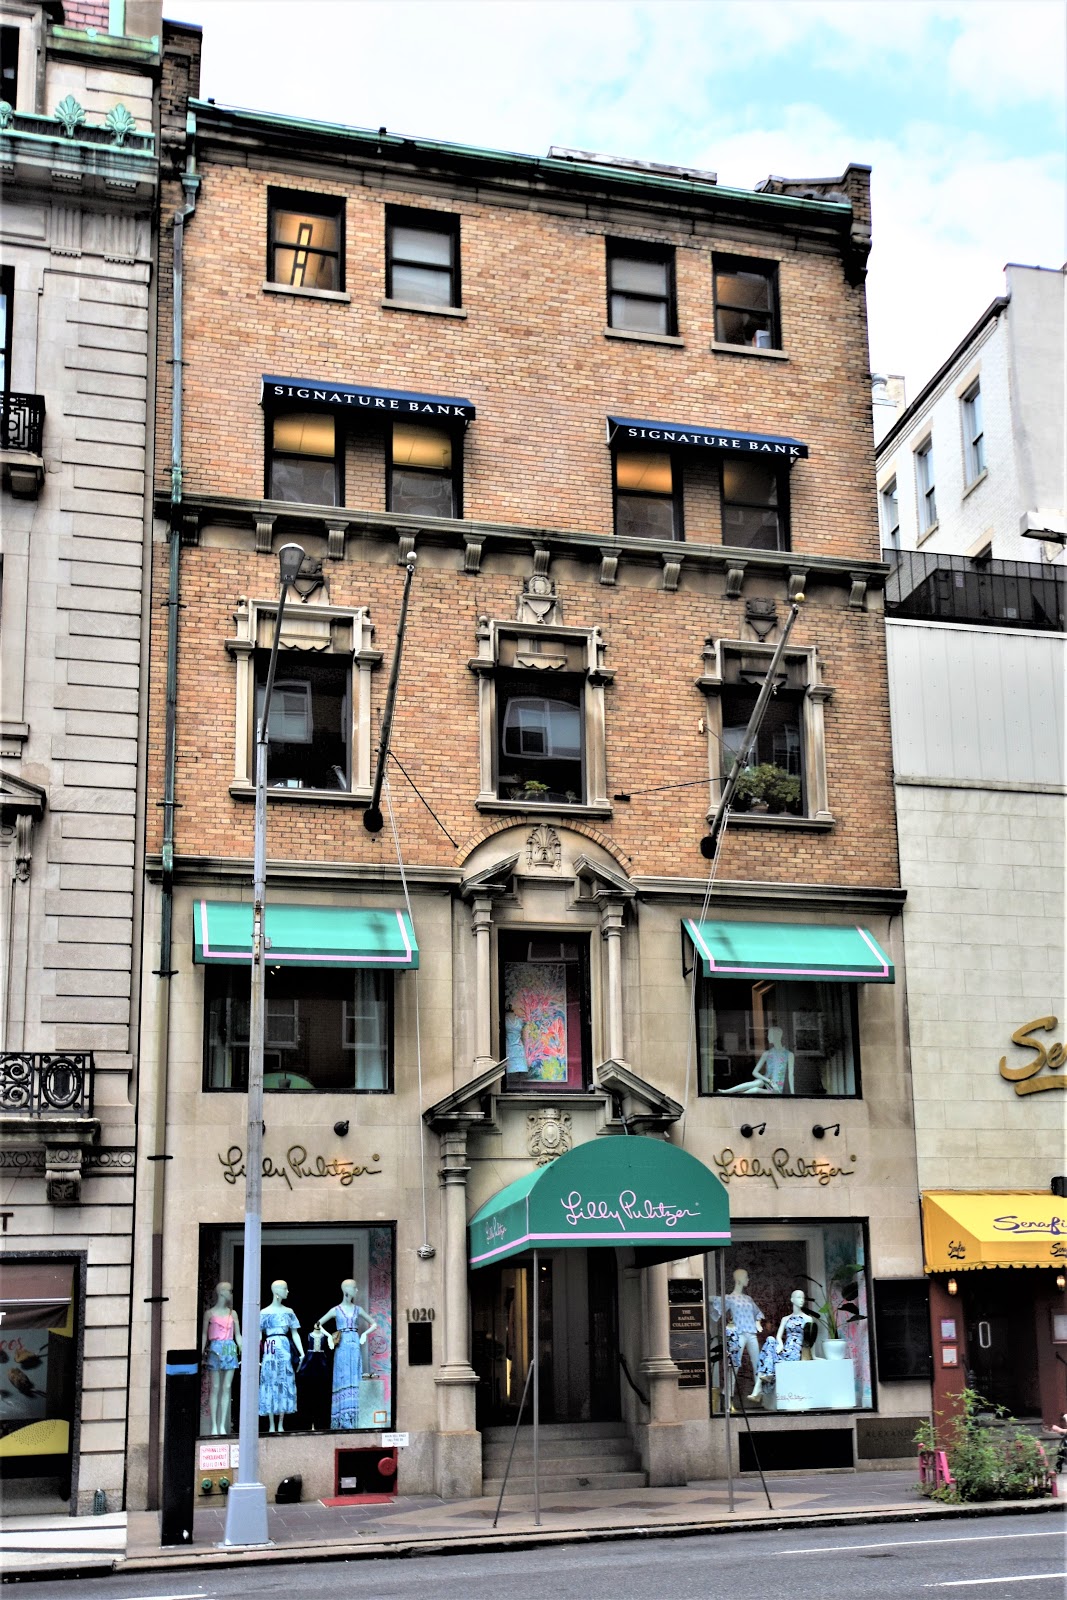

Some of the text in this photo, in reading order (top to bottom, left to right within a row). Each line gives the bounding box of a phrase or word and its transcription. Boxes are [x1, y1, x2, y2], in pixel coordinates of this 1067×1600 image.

[274, 385, 465, 416] SIGNATURE BANK
[628, 428, 801, 455] SIGNATURE BANK
[286, 1145, 382, 1186] Pulitzer
[713, 1147, 854, 1189] Lilly Pulitzer
[560, 1189, 701, 1231] Lilly Pulitzer
[406, 1307, 435, 1322] 1020
